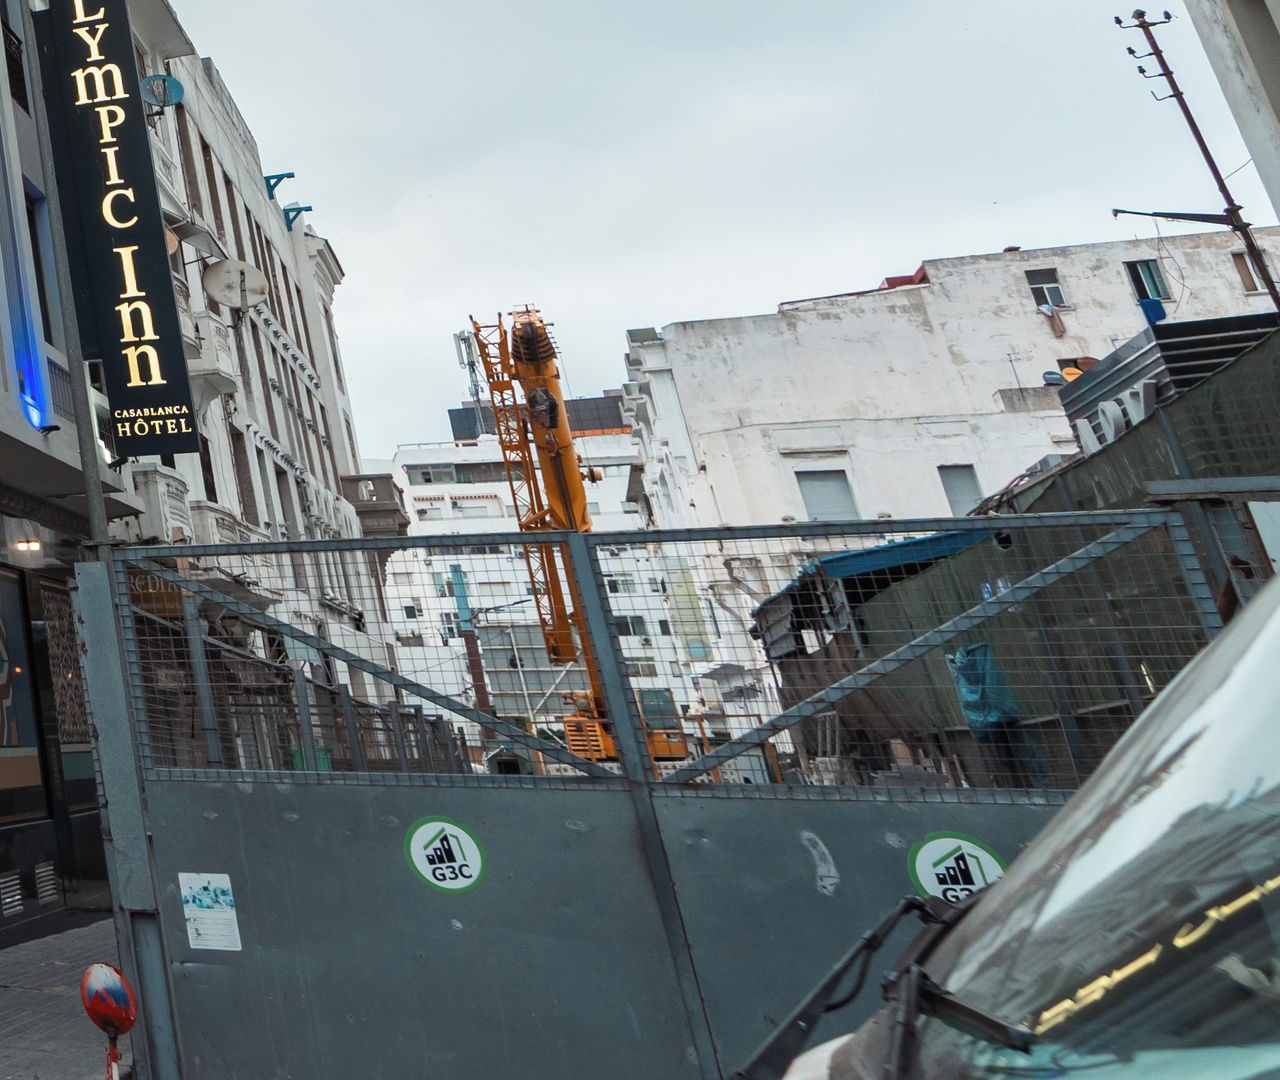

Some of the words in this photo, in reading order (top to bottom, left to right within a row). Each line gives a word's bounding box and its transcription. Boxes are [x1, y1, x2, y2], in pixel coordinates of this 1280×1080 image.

[112, 246, 167, 388] Inn
[114, 405, 189, 418] CASABLANCA
[116, 418, 192, 437] HÔTEL
[431, 863, 473, 882] G3C
